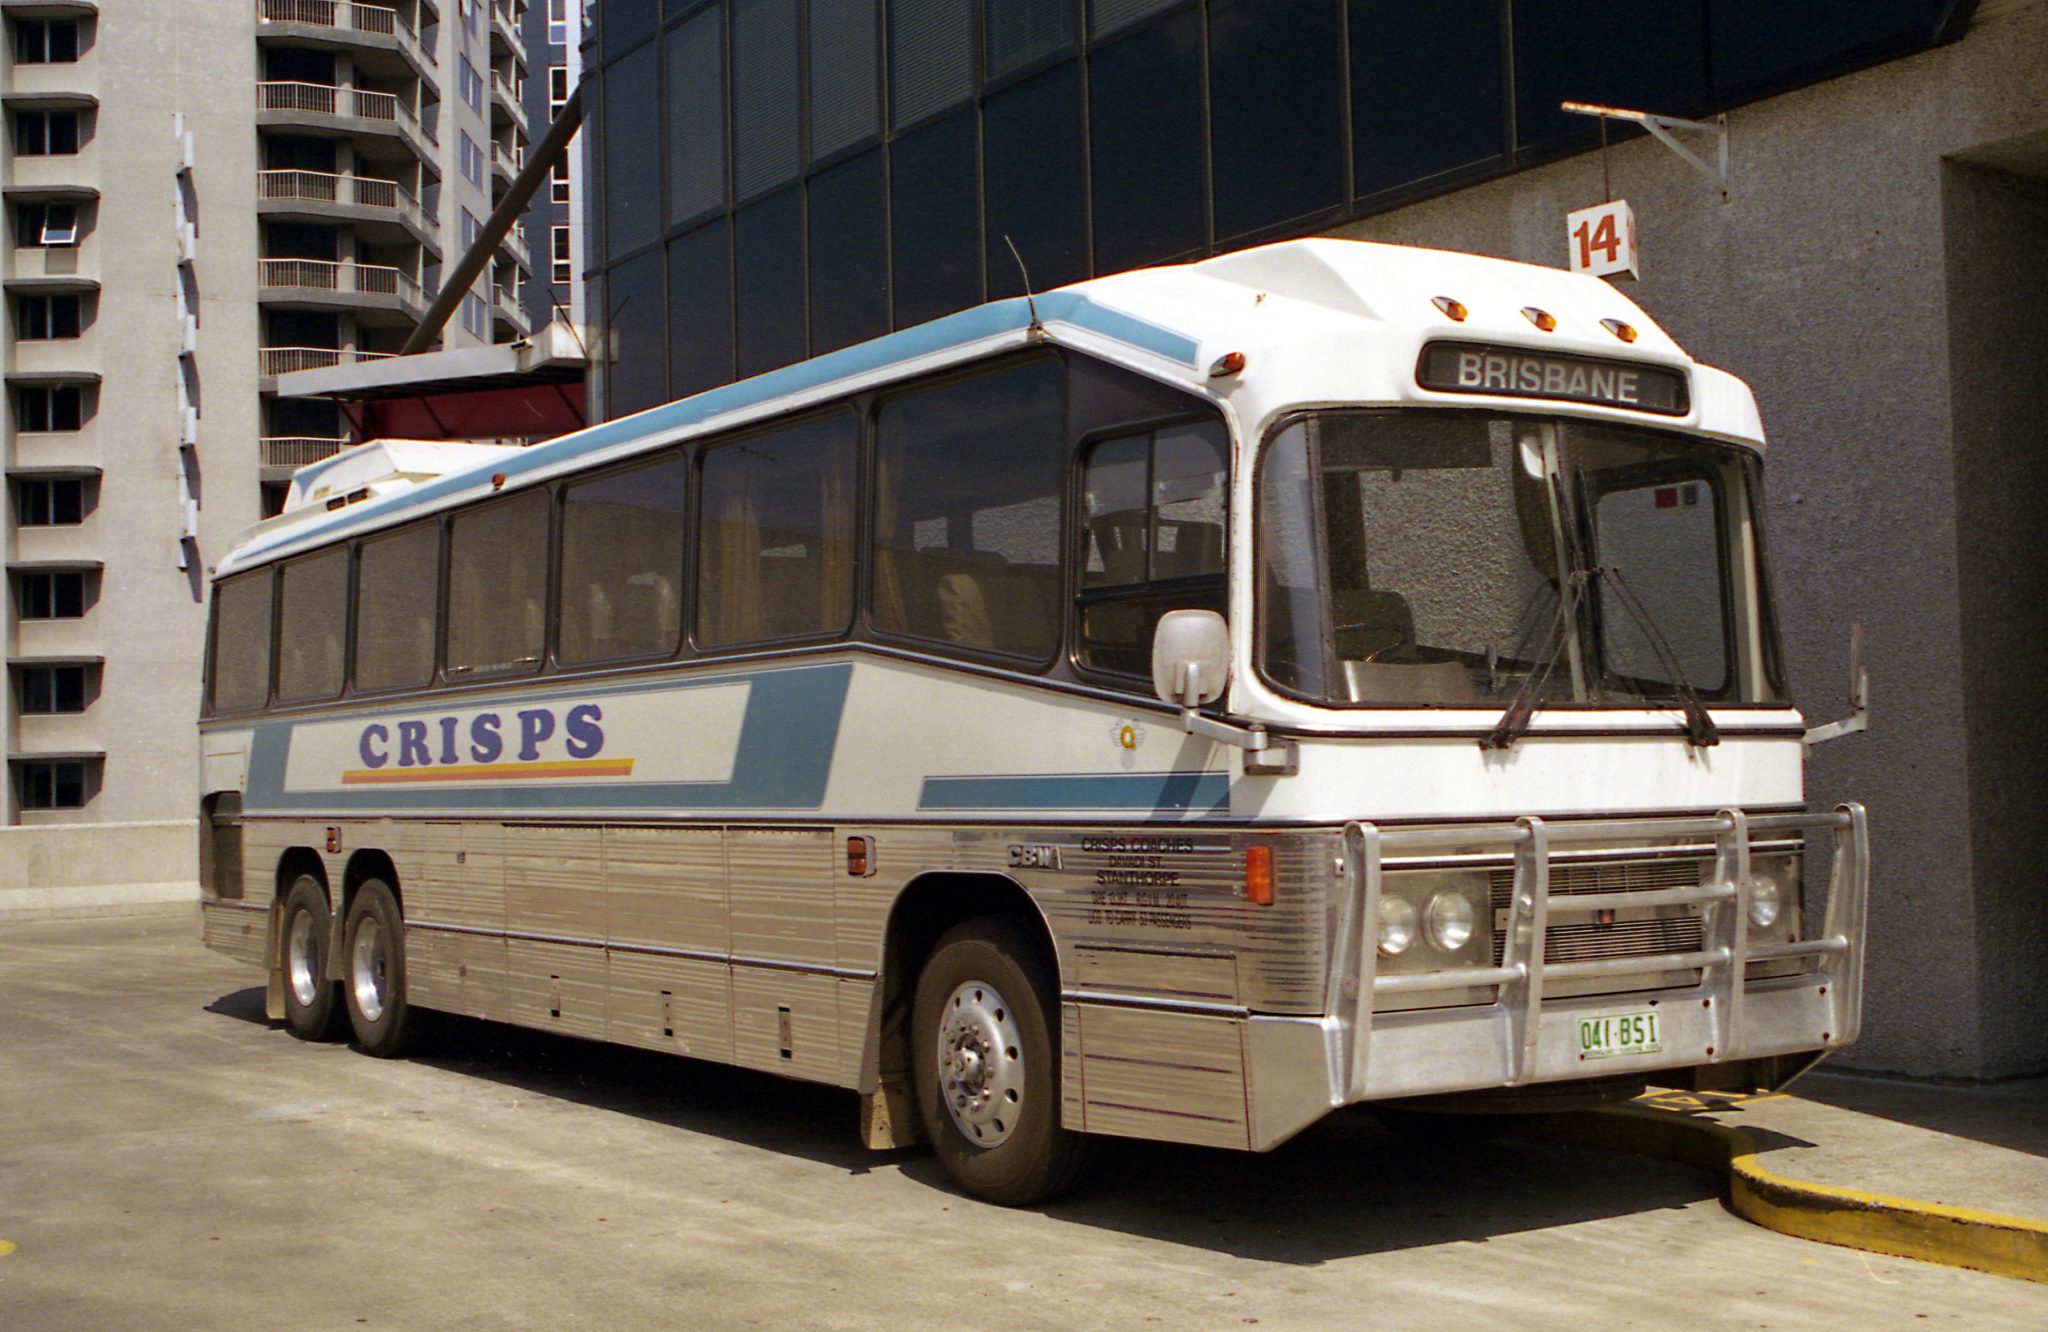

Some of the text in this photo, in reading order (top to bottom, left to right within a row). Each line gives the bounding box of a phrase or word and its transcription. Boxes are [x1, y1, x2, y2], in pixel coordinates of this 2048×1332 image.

[1573, 214, 1621, 269] 14
[1458, 352, 1638, 403] BRISBANE
[359, 703, 605, 769] CRISPS
[1081, 837, 1194, 853] CRISPS COACHES
[1096, 870, 1181, 887] STANTHORPE
